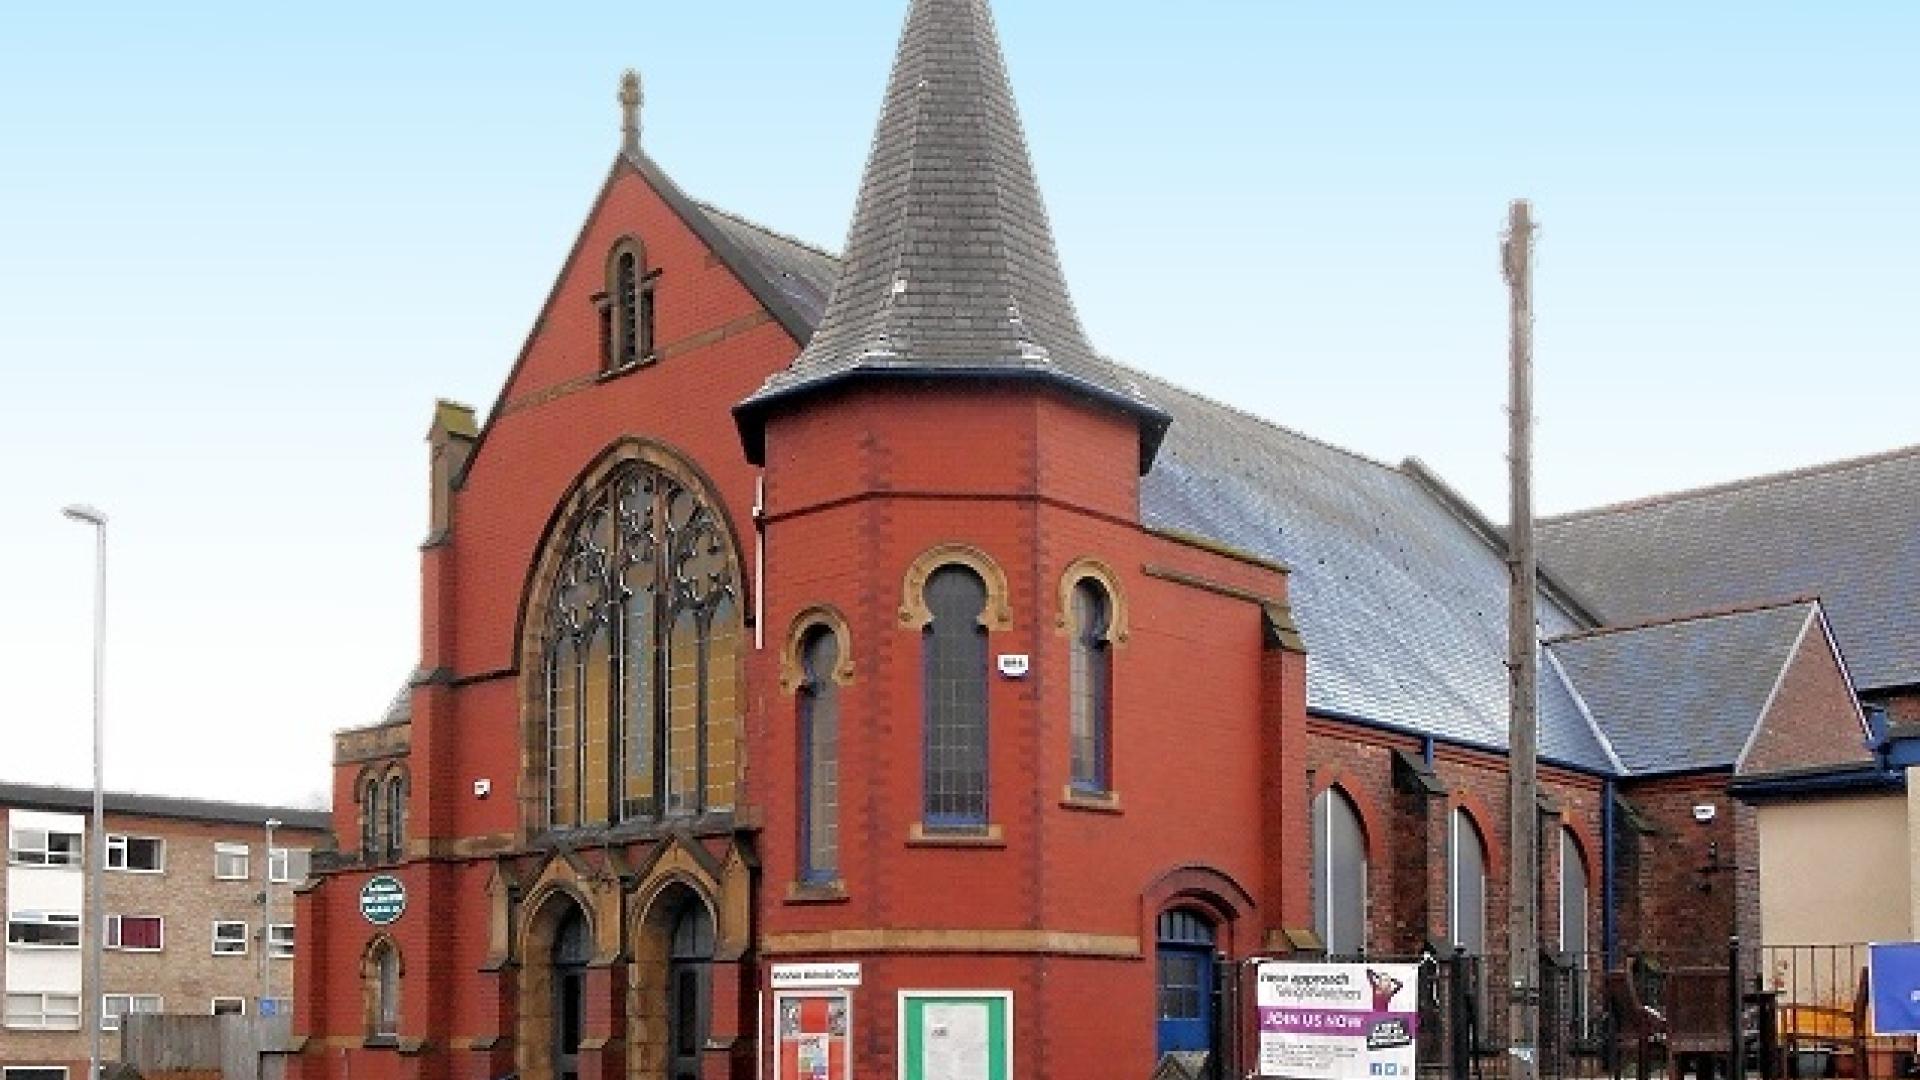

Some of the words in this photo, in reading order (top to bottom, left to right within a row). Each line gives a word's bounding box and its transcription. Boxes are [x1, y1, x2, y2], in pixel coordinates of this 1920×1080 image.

[1263, 1011, 1300, 1025] JOIN
[1302, 1014, 1322, 1028] US
[1324, 1014, 1362, 1028] NOW
